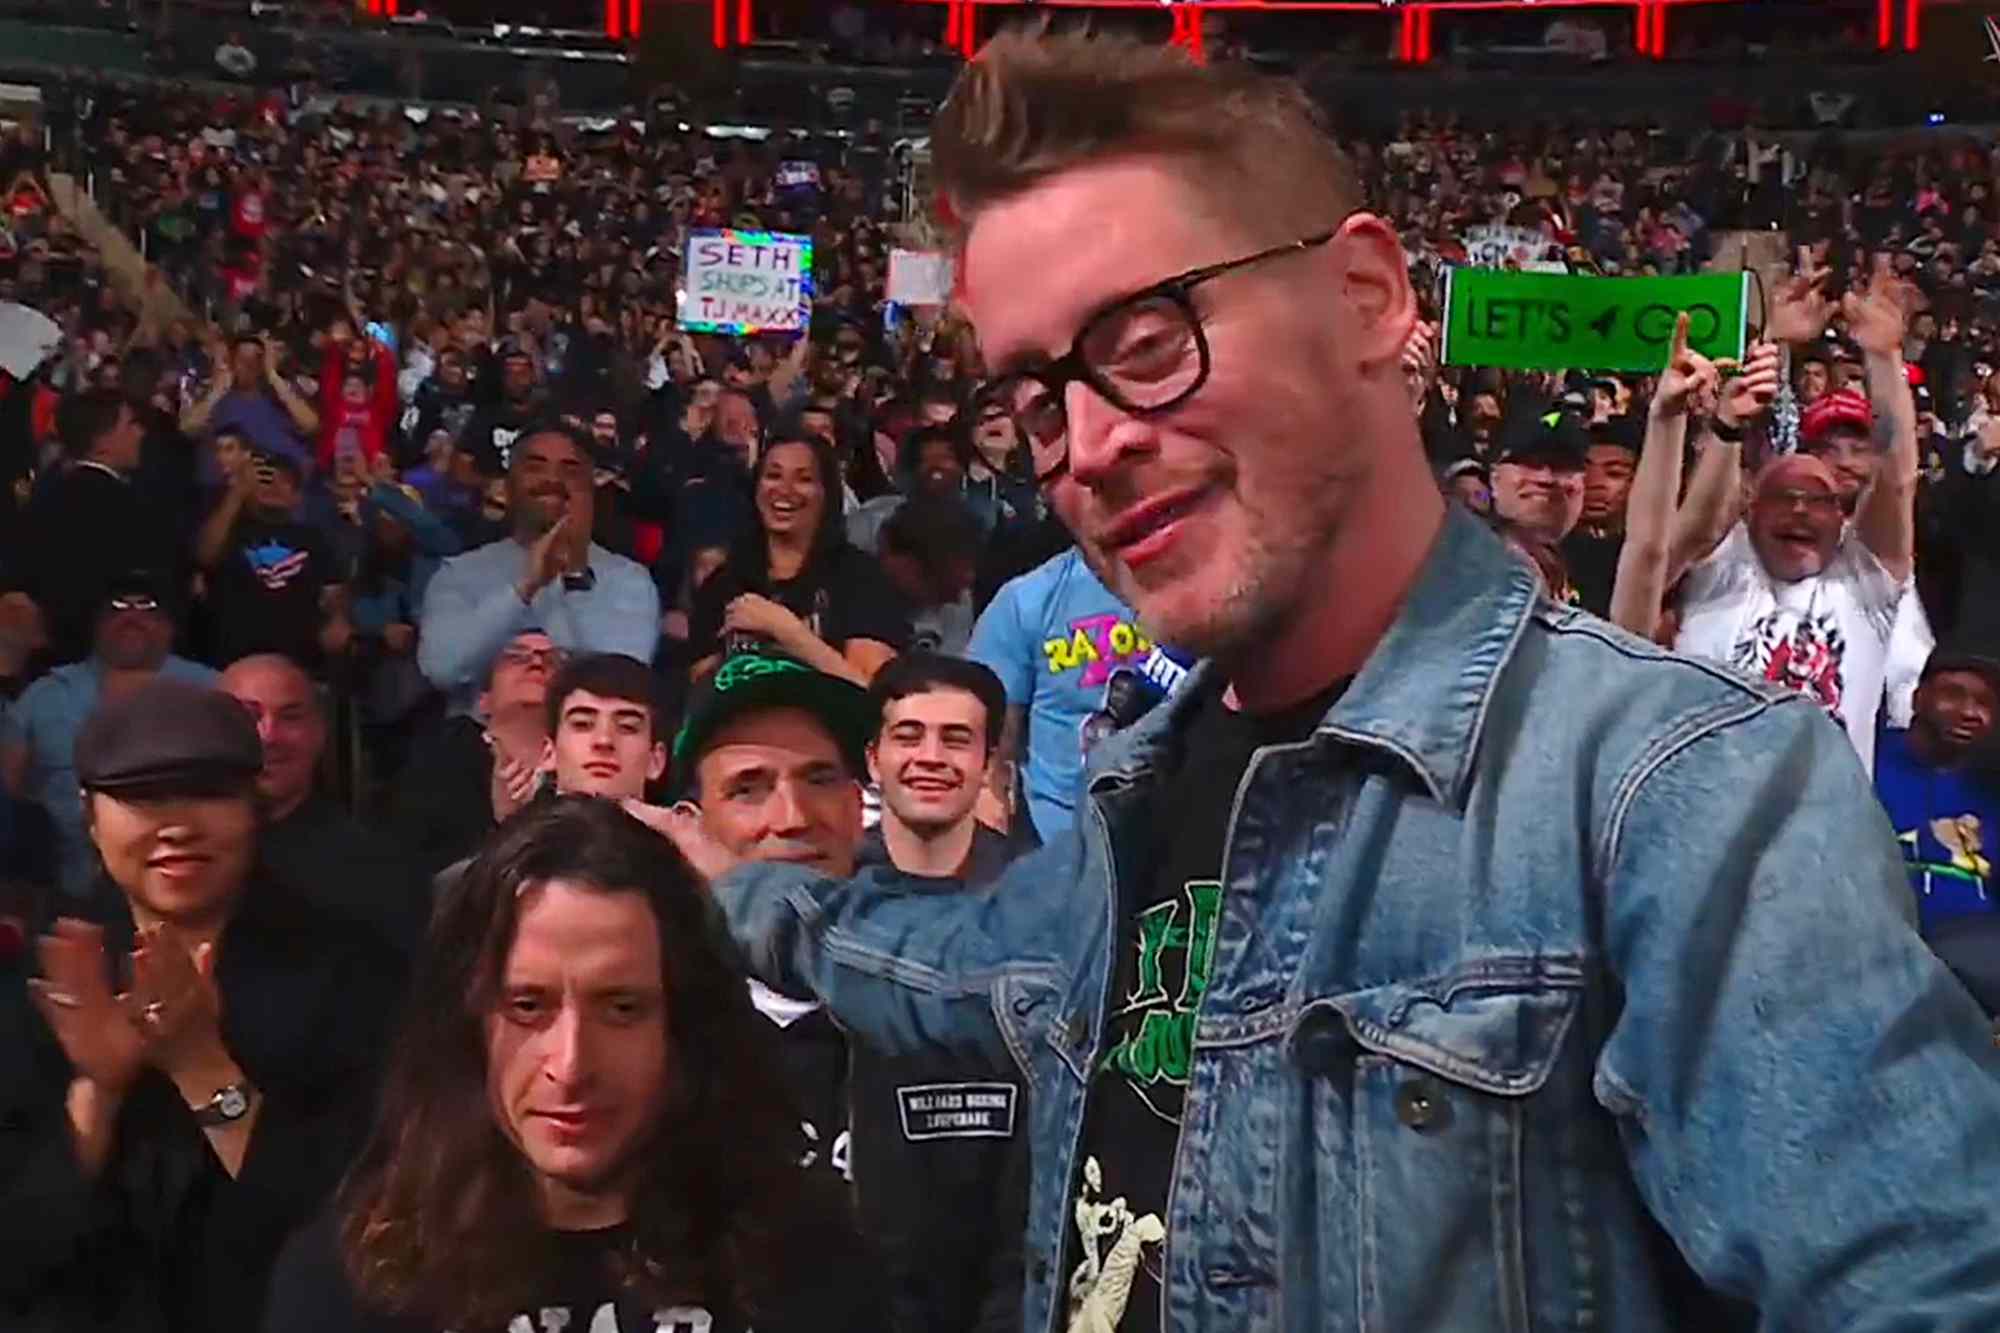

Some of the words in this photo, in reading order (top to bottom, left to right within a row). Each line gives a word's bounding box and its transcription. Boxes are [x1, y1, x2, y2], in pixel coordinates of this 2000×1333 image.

[698, 243, 791, 270] SETH
[701, 270, 768, 297] SHOPS
[1467, 297, 1571, 344] LET'S
[1634, 303, 1721, 347] GO
[1043, 613, 1152, 688] RAZO
